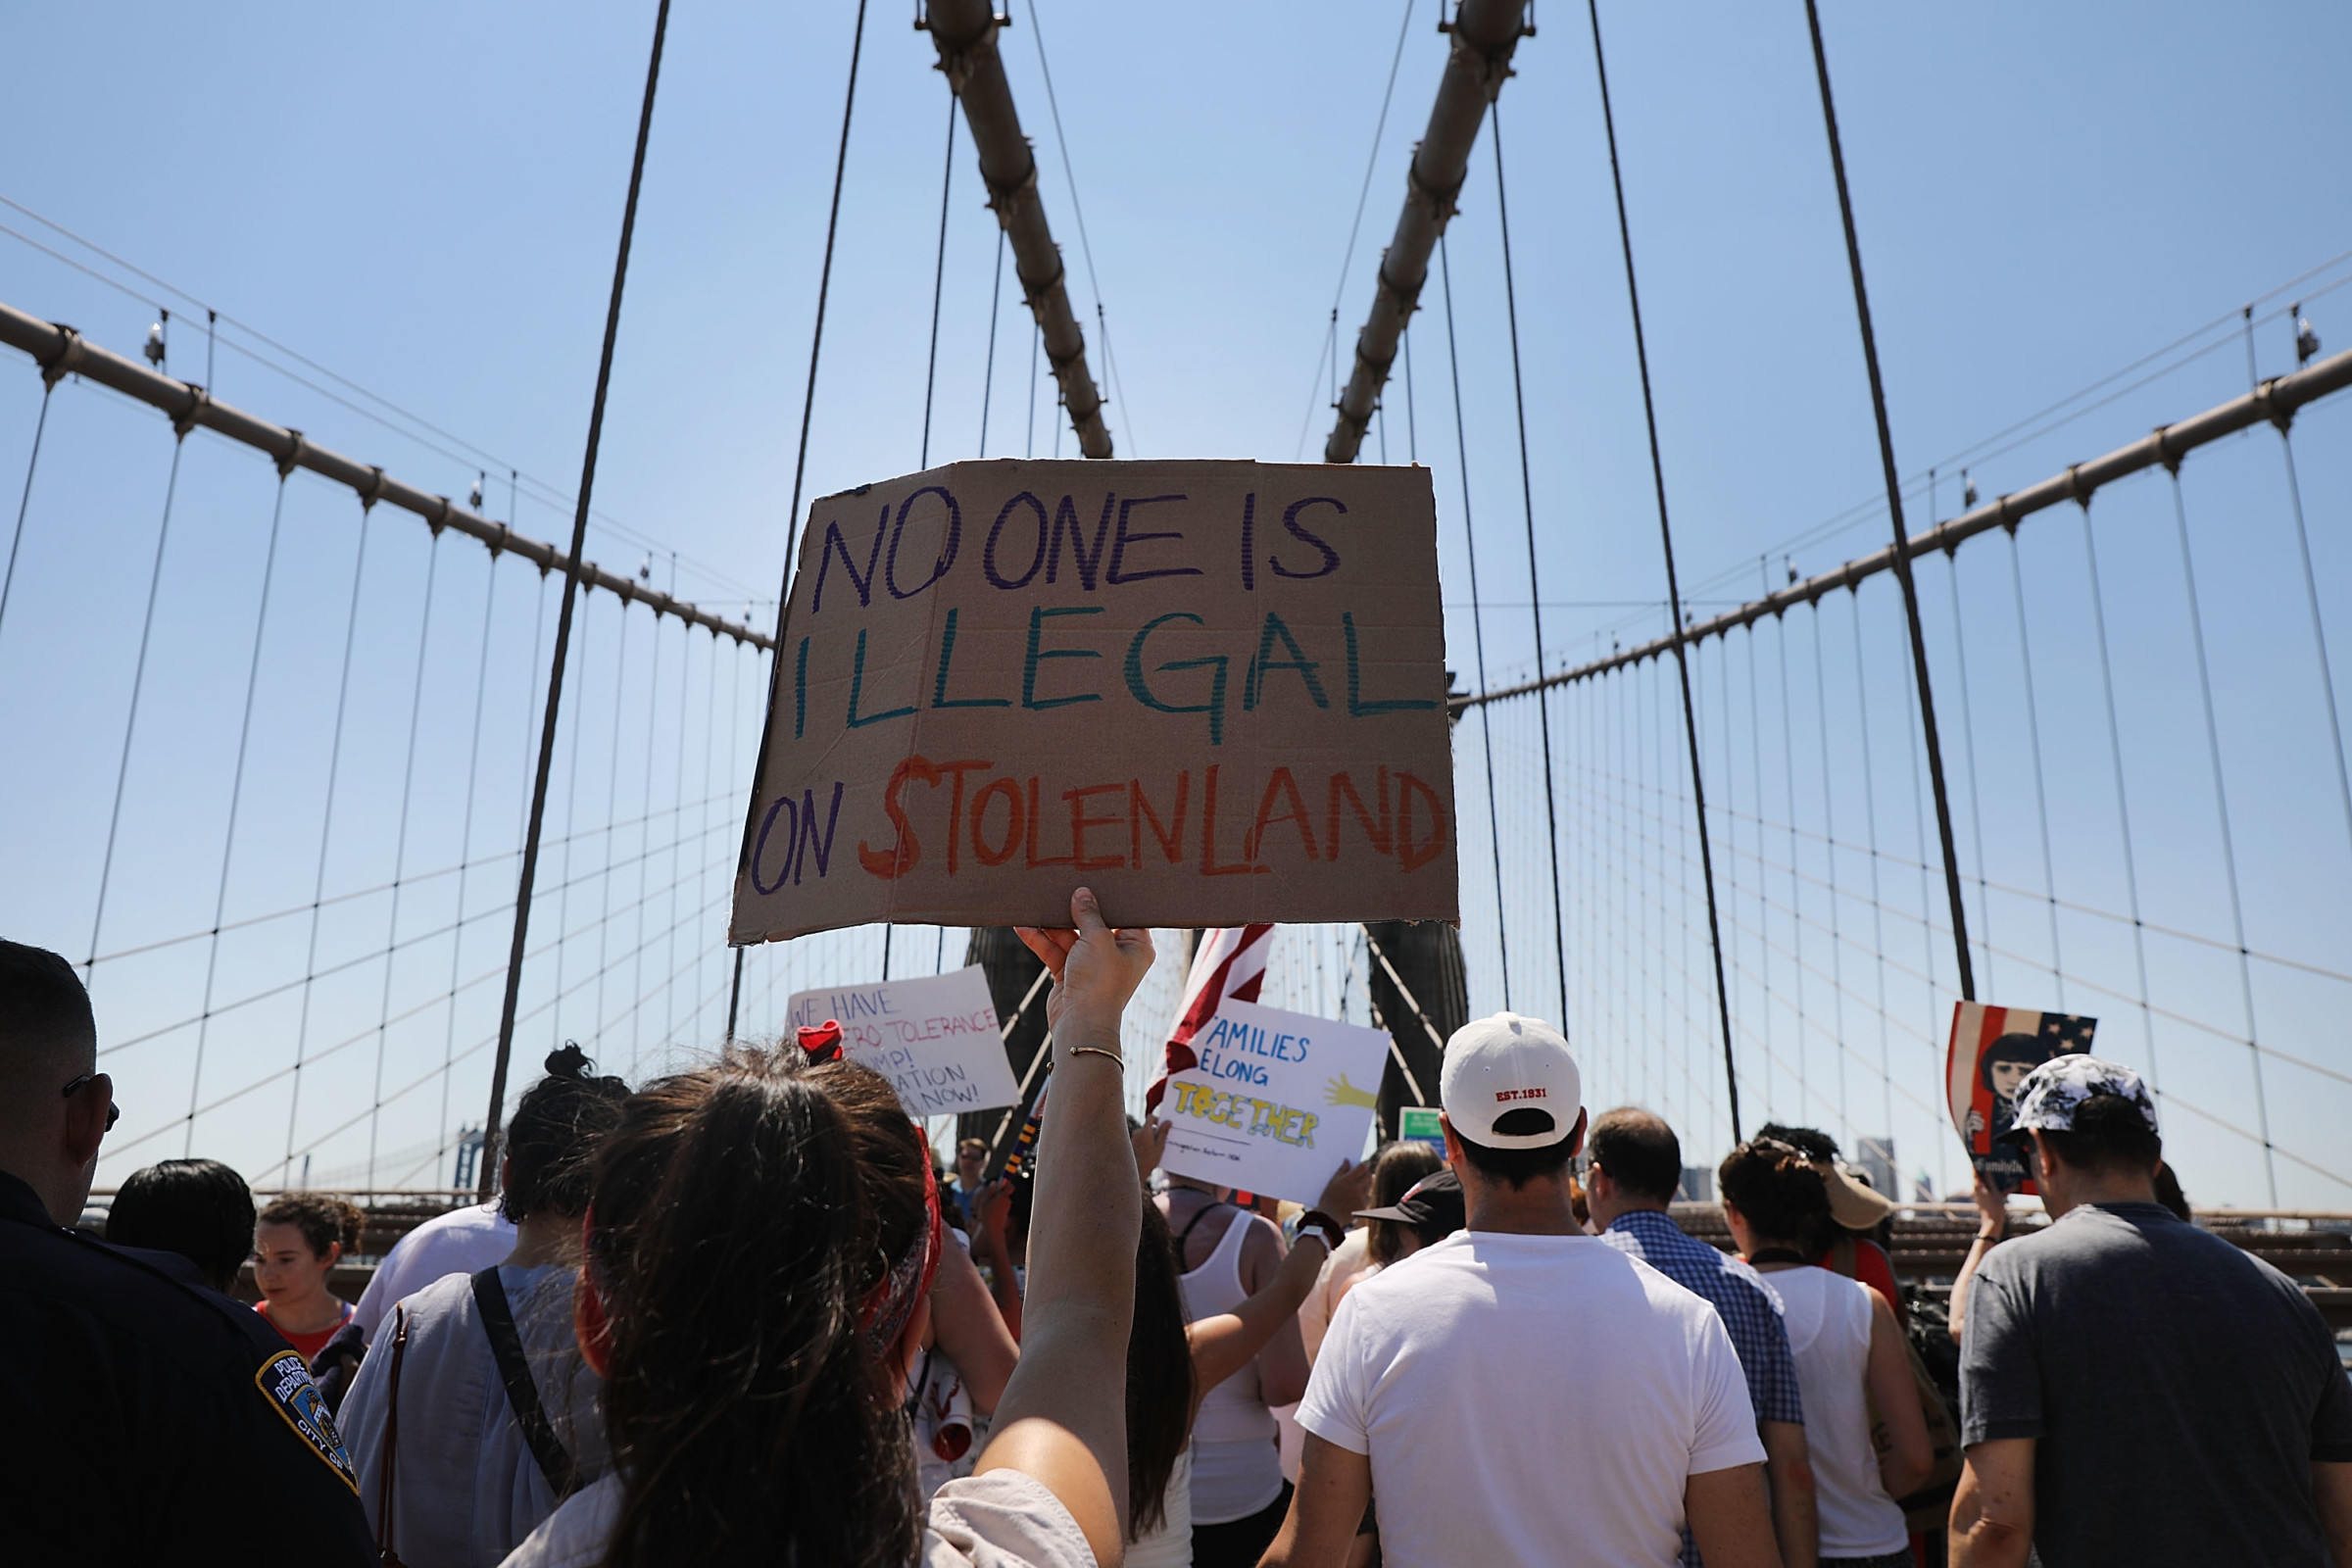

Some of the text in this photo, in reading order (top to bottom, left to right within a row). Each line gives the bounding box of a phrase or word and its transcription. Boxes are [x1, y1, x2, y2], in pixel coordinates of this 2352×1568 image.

[812, 486, 1348, 613] NO ONE IS
[795, 606, 1439, 745] ILLEGAL
[751, 782, 844, 896] ON
[790, 989, 901, 1028] WE HAVE
[843, 1007, 1002, 1052] ERO TOLERANCE
[1206, 1015, 1310, 1062] AMILIES
[1200, 1048, 1268, 1086] ELONG
[920, 1084, 981, 1109] NOW!
[1173, 1081, 1319, 1149] TOGETHER
[274, 1356, 305, 1378] POLICE
[297, 1419, 343, 1470] CITY OF
